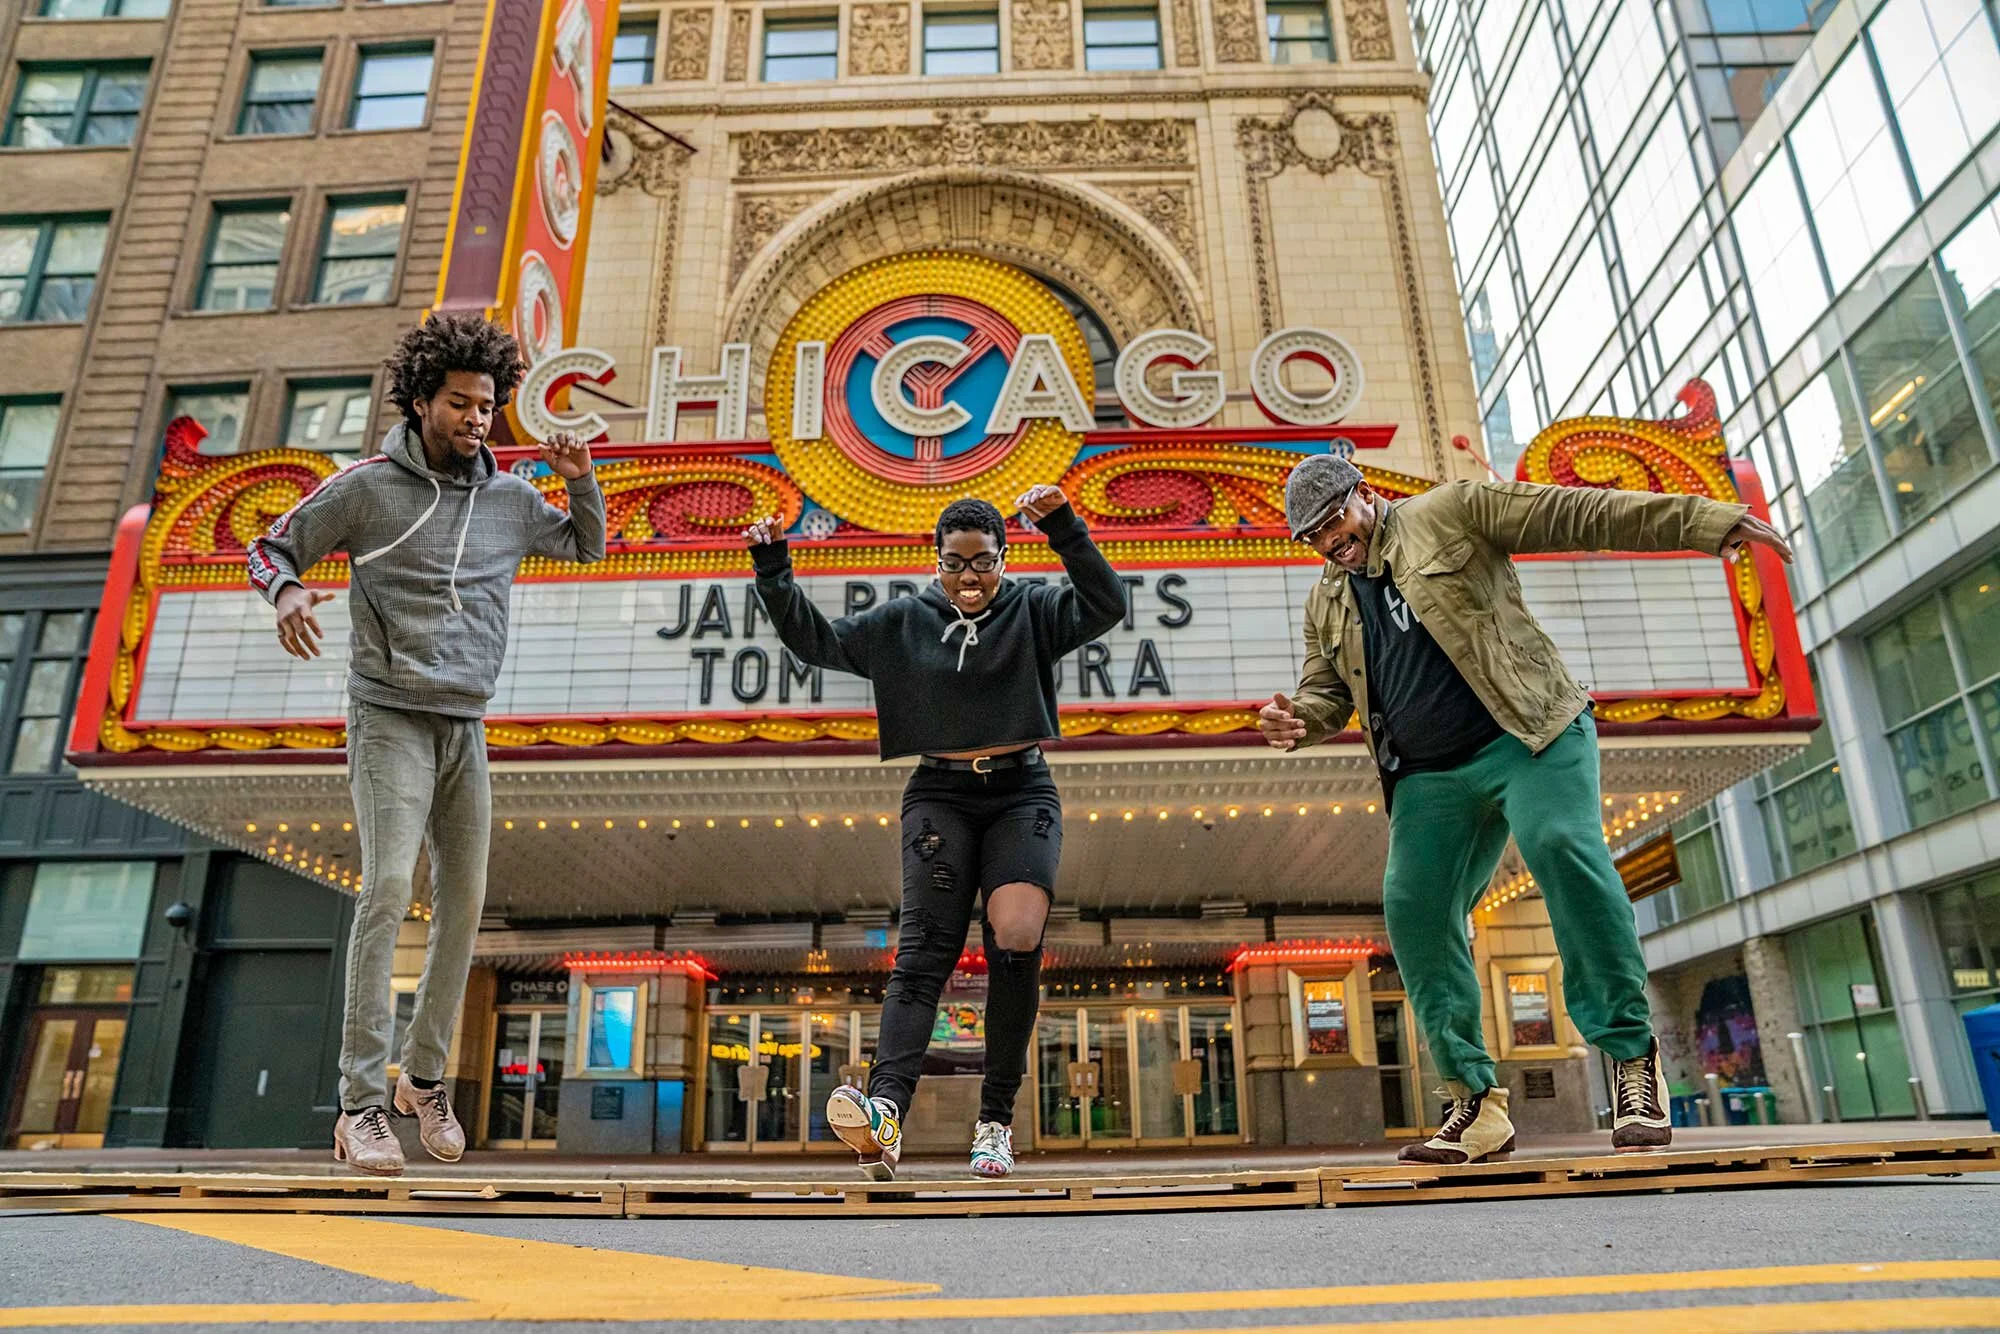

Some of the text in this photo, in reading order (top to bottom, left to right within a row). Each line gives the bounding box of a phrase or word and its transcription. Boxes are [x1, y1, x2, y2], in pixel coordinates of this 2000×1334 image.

[515, 327, 1366, 442] CHICAGO
[691, 645, 822, 705] TOM
[511, 981, 554, 992] CHASE
